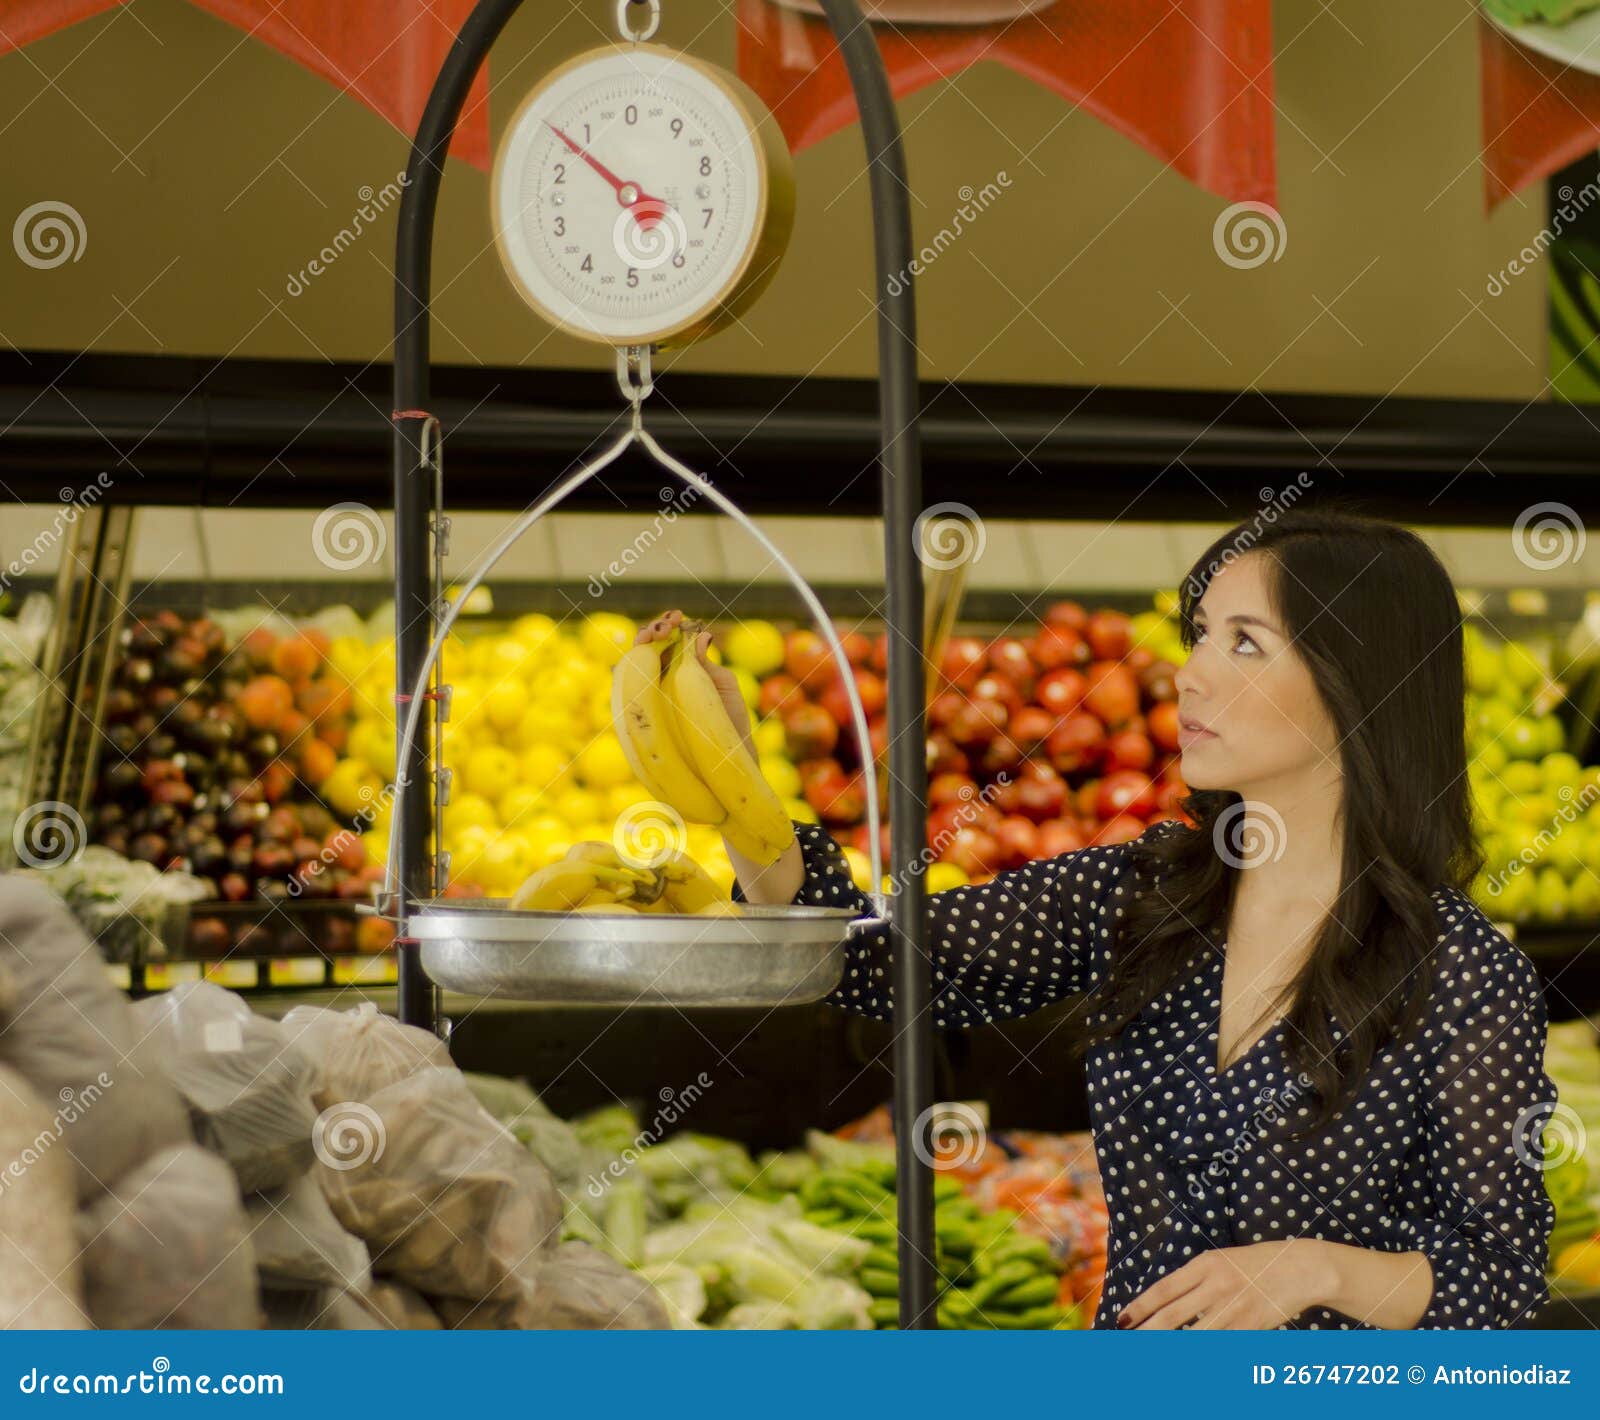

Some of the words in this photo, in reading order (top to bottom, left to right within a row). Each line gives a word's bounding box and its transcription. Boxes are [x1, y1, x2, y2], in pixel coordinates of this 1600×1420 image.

[625, 104, 638, 126] 0
[583, 123, 591, 144] 1
[671, 118, 684, 140] 9
[553, 164, 567, 185] 2
[699, 156, 712, 177] 8
[553, 216, 566, 237] 3
[701, 207, 715, 229] 7
[580, 253, 595, 275] 4
[672, 248, 686, 269] 6
[626, 267, 640, 289] 5
